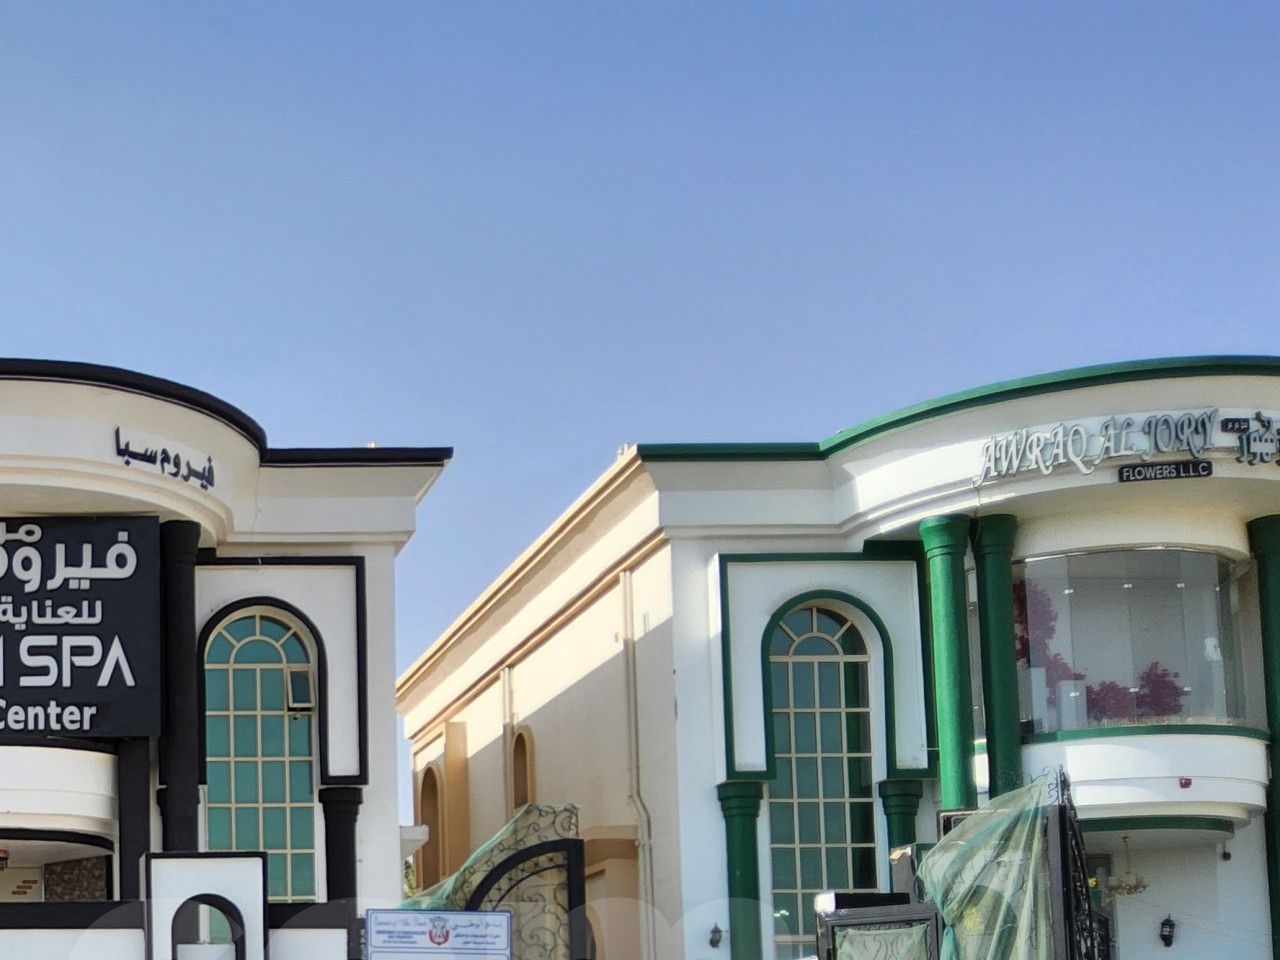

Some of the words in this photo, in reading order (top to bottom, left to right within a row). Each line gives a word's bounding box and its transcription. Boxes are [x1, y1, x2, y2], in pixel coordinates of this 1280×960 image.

[114, 426, 158, 468] سبا
[972, 423, 1095, 488] AWRAQ
[1095, 416, 1142, 464] AL
[1140, 408, 1219, 462] JORY
[161, 452, 215, 490] فيروم
[1123, 464, 1177, 480] FLOWERS
[1180, 461, 1210, 476] L.L.C
[19, 634, 136, 688] SPA
